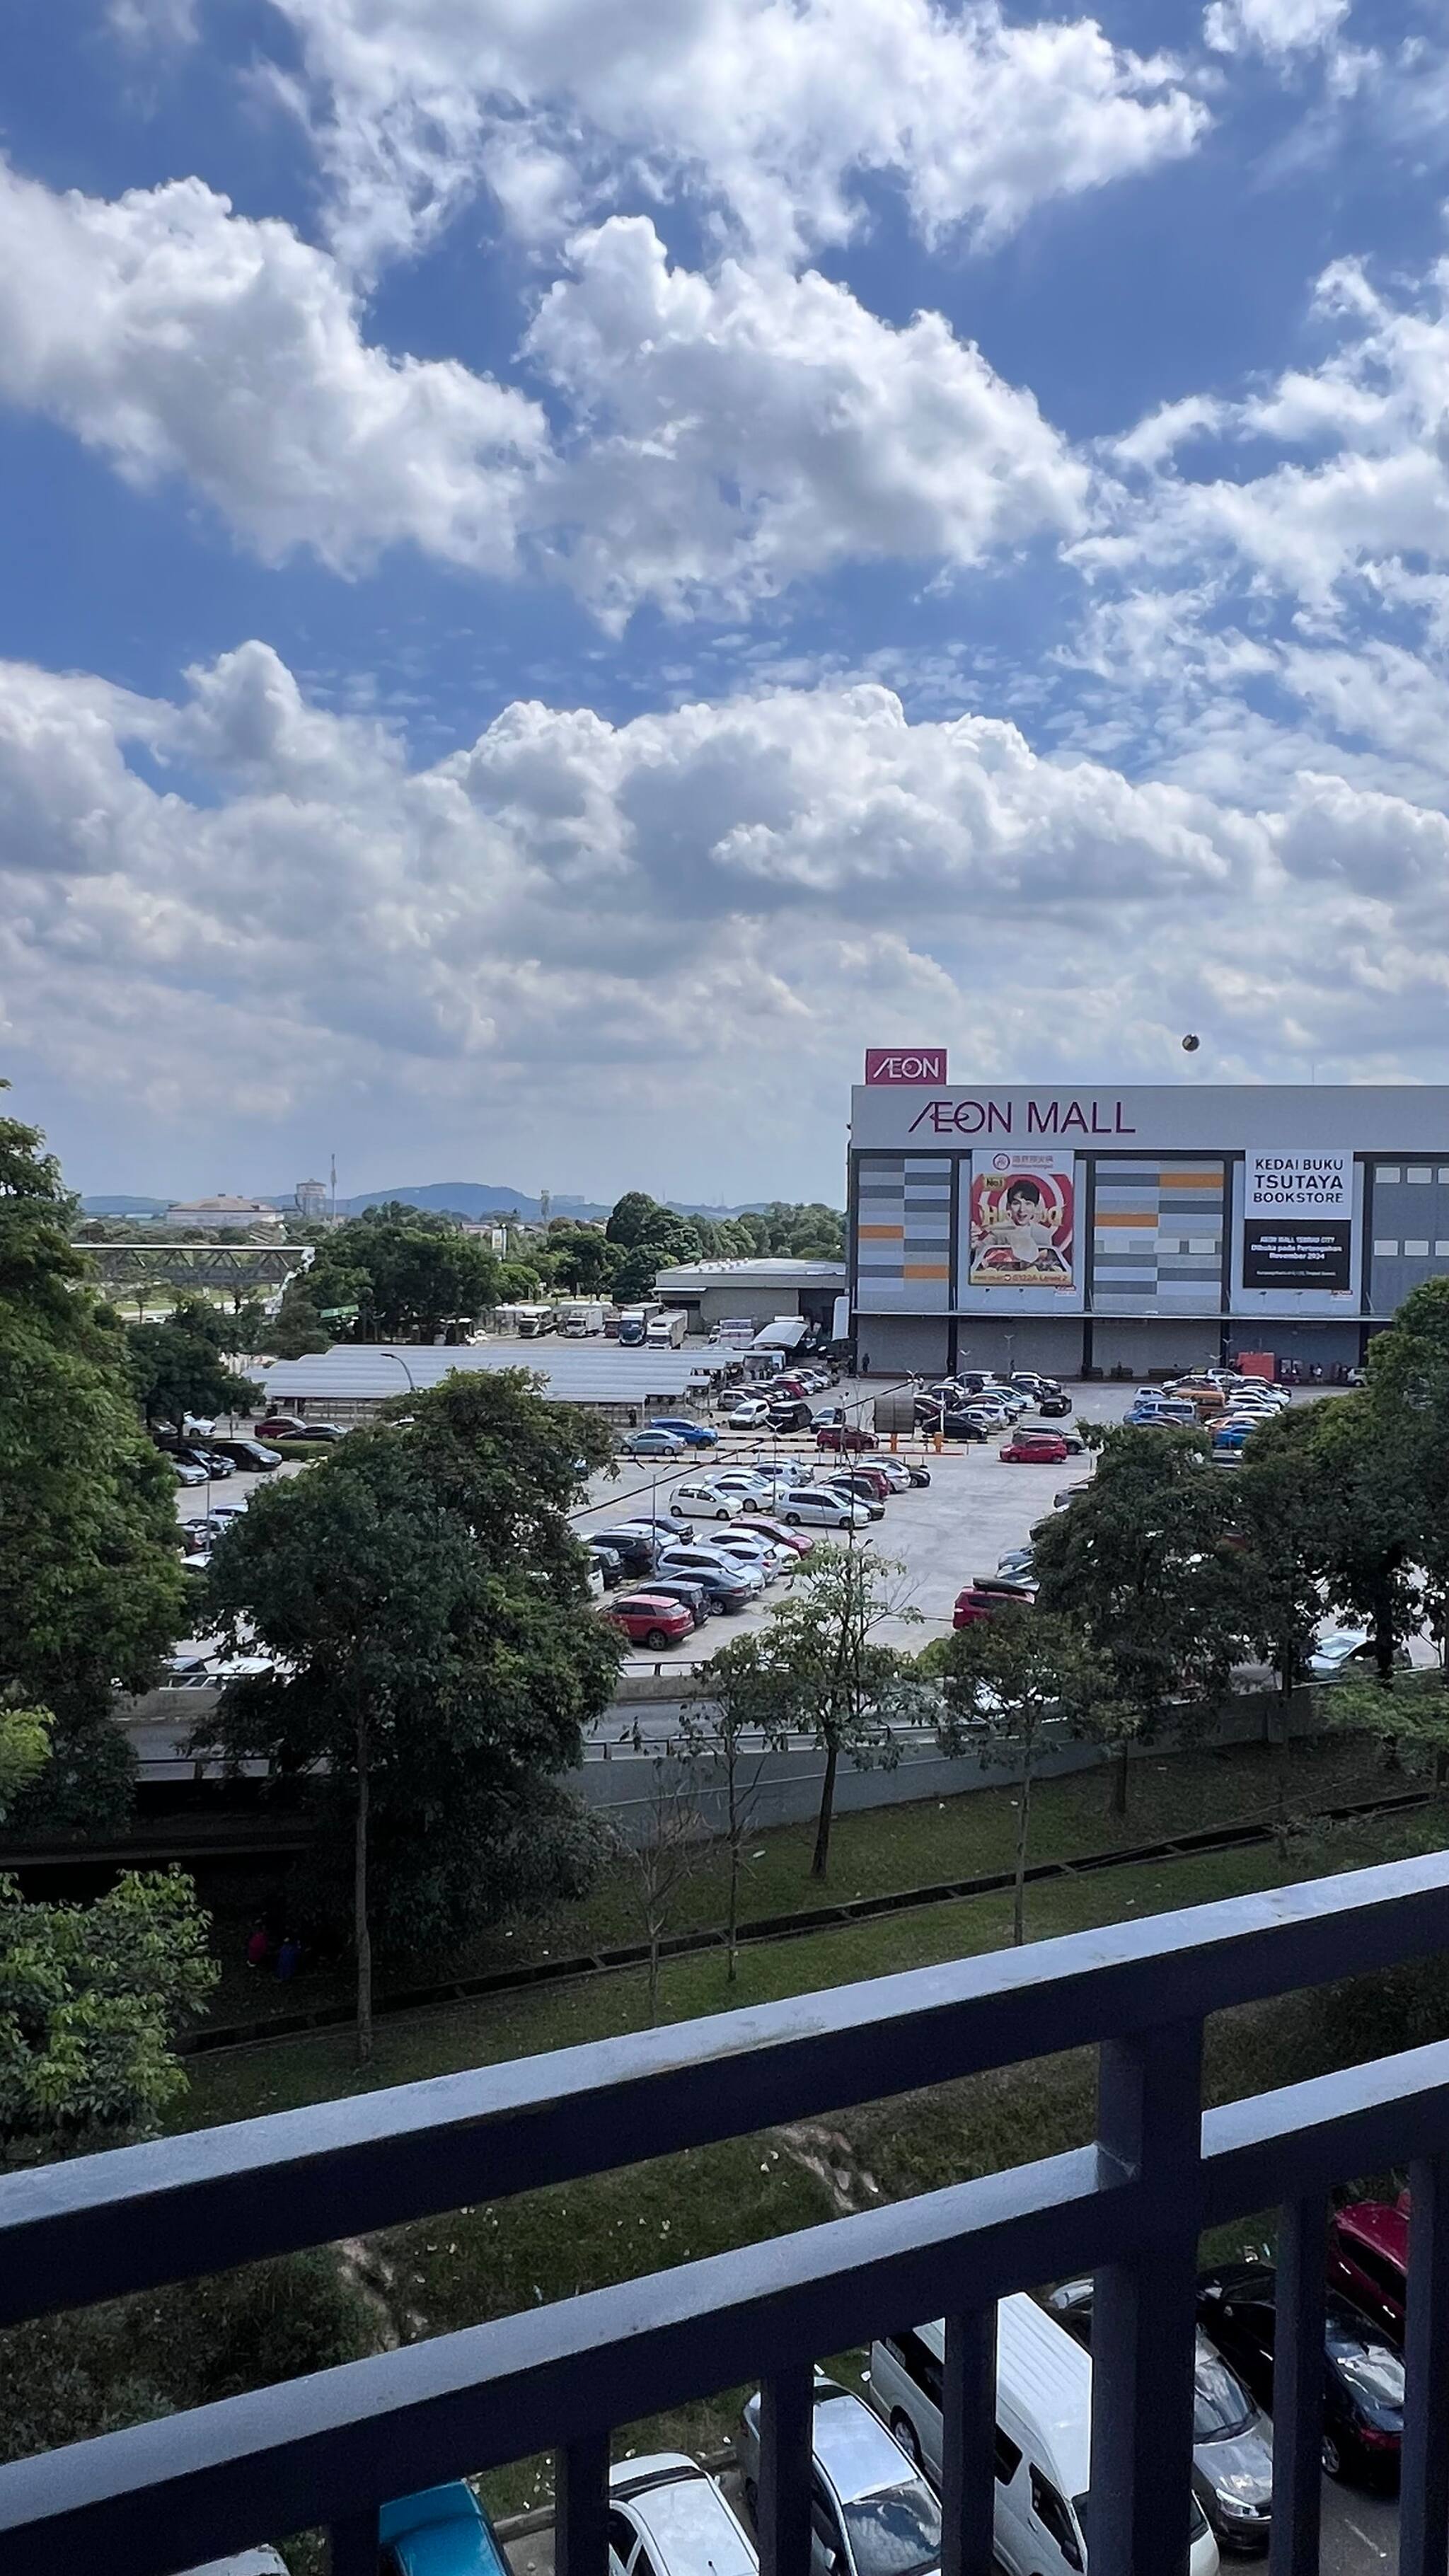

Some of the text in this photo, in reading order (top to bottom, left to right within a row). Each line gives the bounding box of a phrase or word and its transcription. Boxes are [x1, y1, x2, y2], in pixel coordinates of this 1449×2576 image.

[1028, 1101, 1136, 1133] MALL
[1255, 1159, 1344, 1170] KEDAI BUKU
[1254, 1174, 1344, 1189] TSUTAYA
[1253, 1192, 1344, 1203] BOOKSTORE
